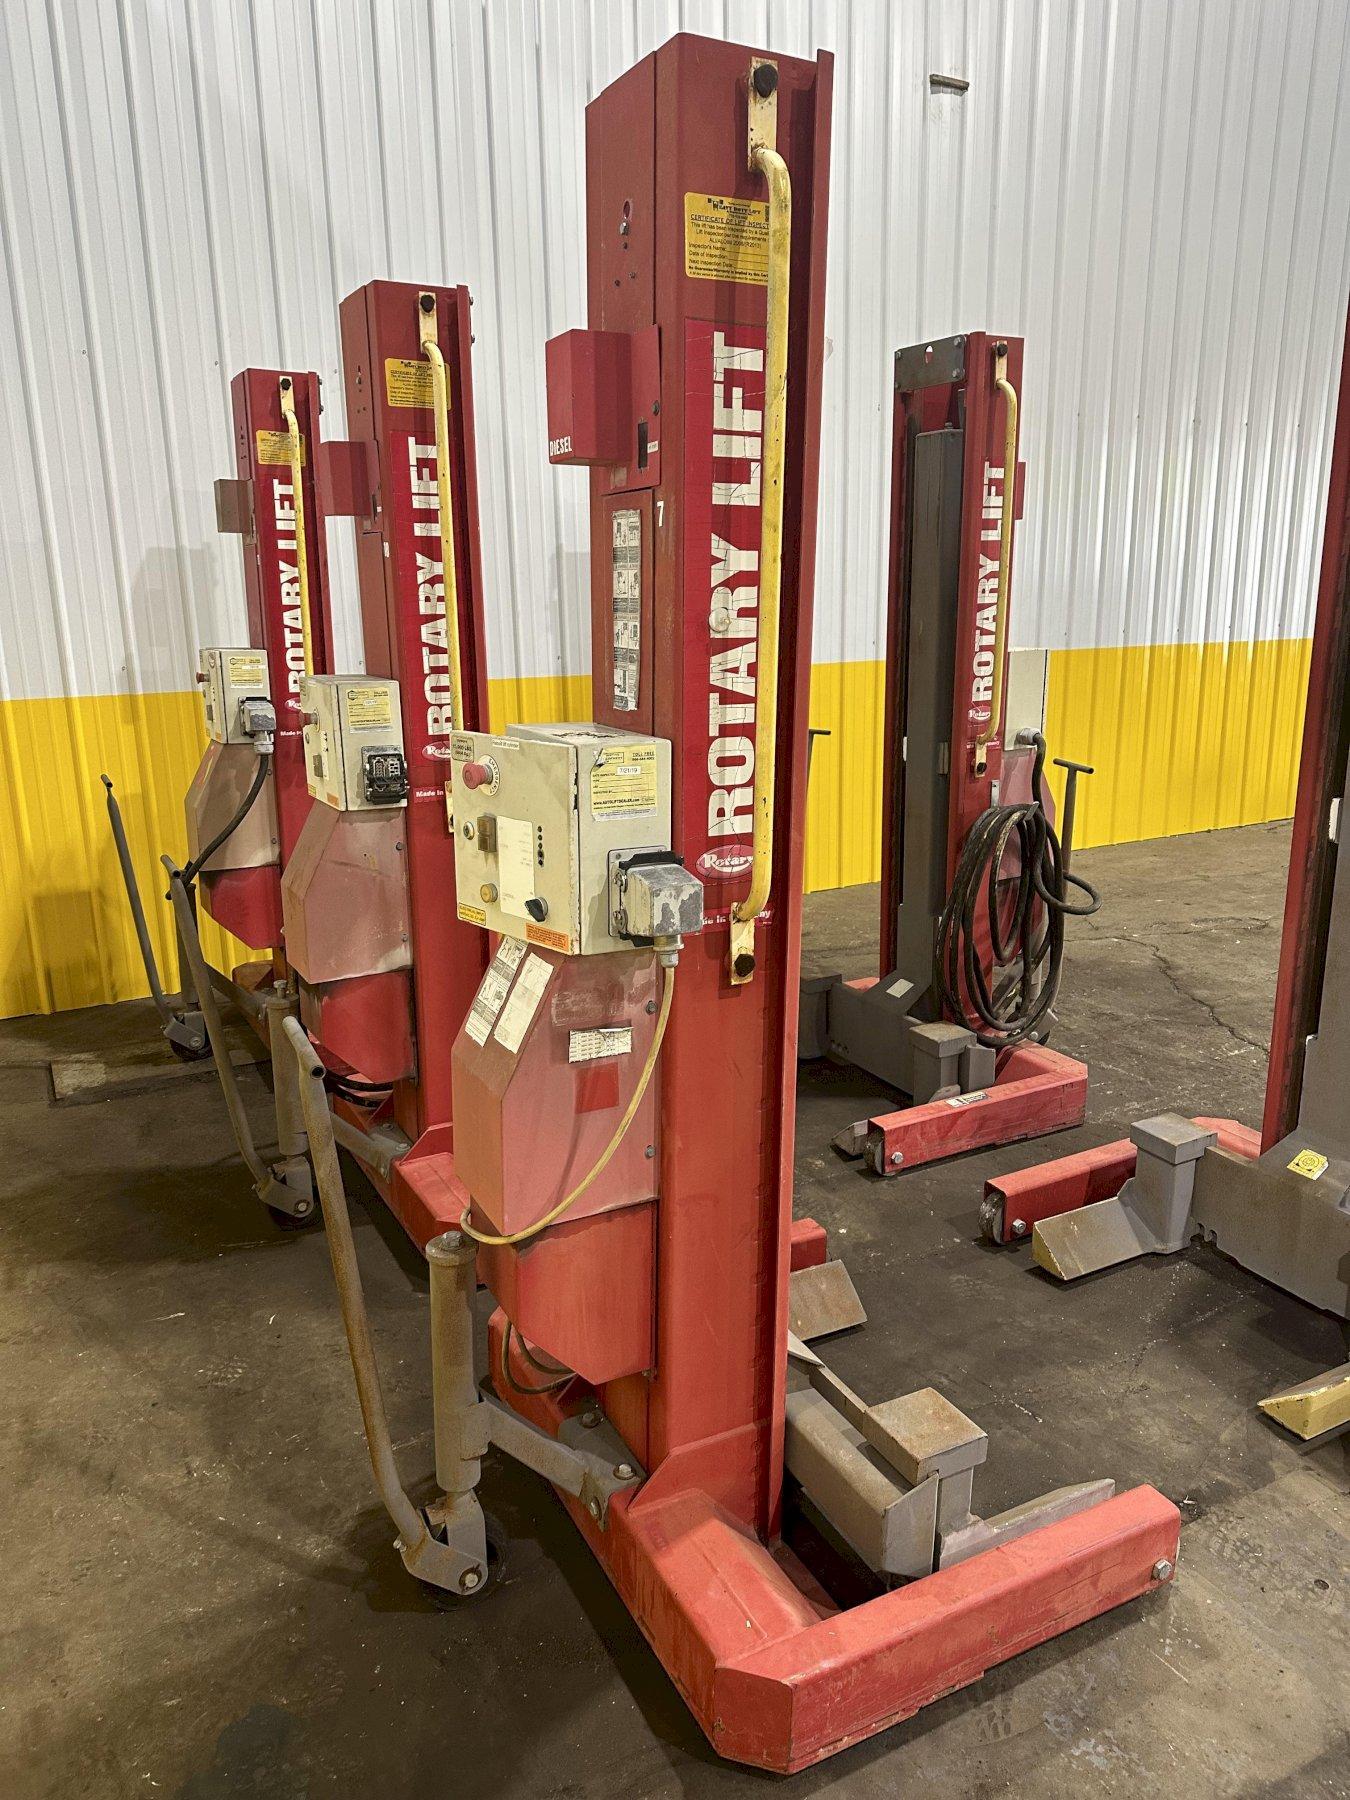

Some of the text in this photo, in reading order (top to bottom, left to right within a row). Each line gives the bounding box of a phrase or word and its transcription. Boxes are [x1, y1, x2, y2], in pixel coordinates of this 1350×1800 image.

[690, 214, 724, 223] CERTIFICATE
[747, 221, 769, 229] INSPECT
[712, 331, 763, 507] LIFT
[549, 435, 573, 456] DIESEL
[656, 500, 664, 527] 7
[980, 461, 1005, 541] LIFT
[972, 553, 1000, 702] ROTARY
[708, 532, 759, 837] ROTARY
[426, 745, 451, 759] Rota
[415, 790, 435, 798] Made
